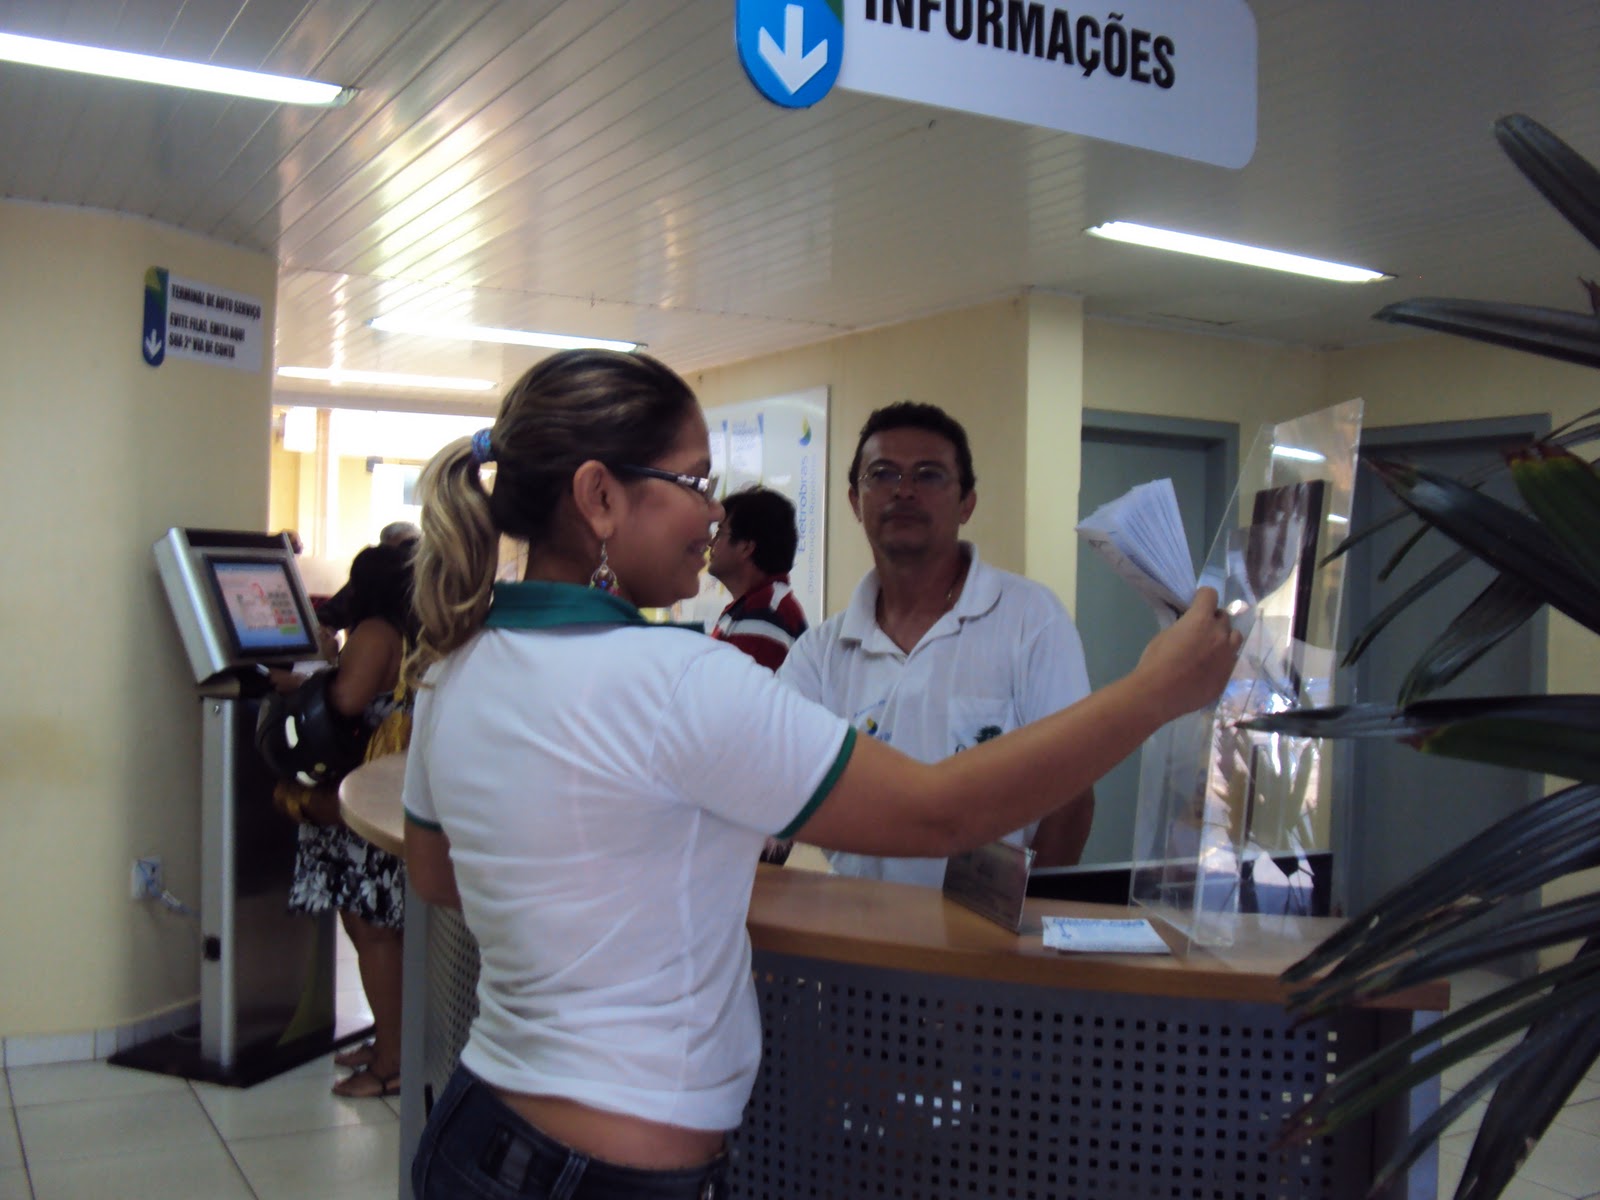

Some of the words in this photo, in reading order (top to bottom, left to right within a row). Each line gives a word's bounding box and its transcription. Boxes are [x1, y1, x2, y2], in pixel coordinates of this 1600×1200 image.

[172, 283, 205, 305] TERMINAL
[206, 292, 215, 307] DE
[216, 295, 233, 312] AUTO
[234, 300, 261, 320] SERVIÇO
[170, 312, 188, 329] EVITE
[210, 320, 229, 337] EMITA
[169, 332, 183, 347] SUA
[193, 337, 204, 352] VIA
[214, 342, 235, 358] CONTA
[798, 455, 808, 552] Eletrobras
